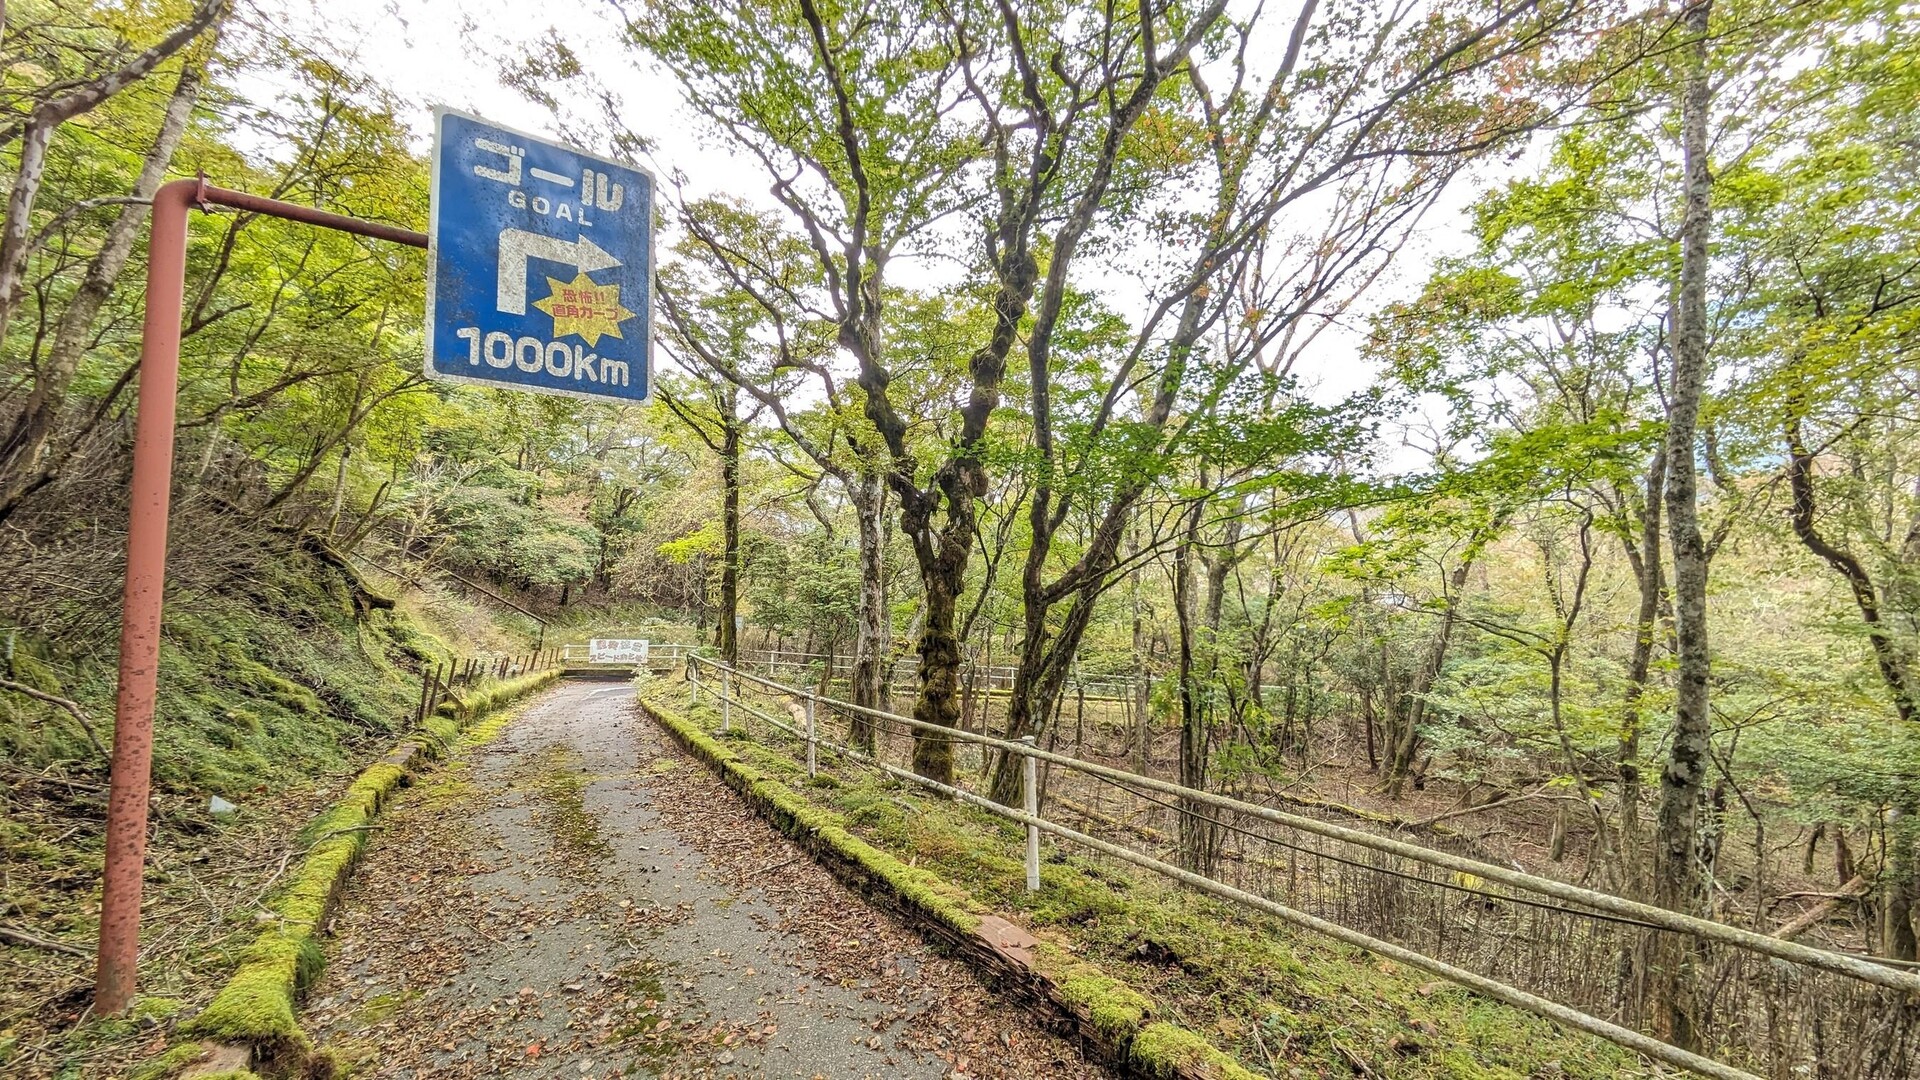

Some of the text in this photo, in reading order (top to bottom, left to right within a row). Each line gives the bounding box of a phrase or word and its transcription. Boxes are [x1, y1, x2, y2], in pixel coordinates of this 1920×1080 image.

[474, 137, 624, 212] ゴール
[508, 189, 593, 227] GOAL
[456, 326, 629, 387] 1000km
